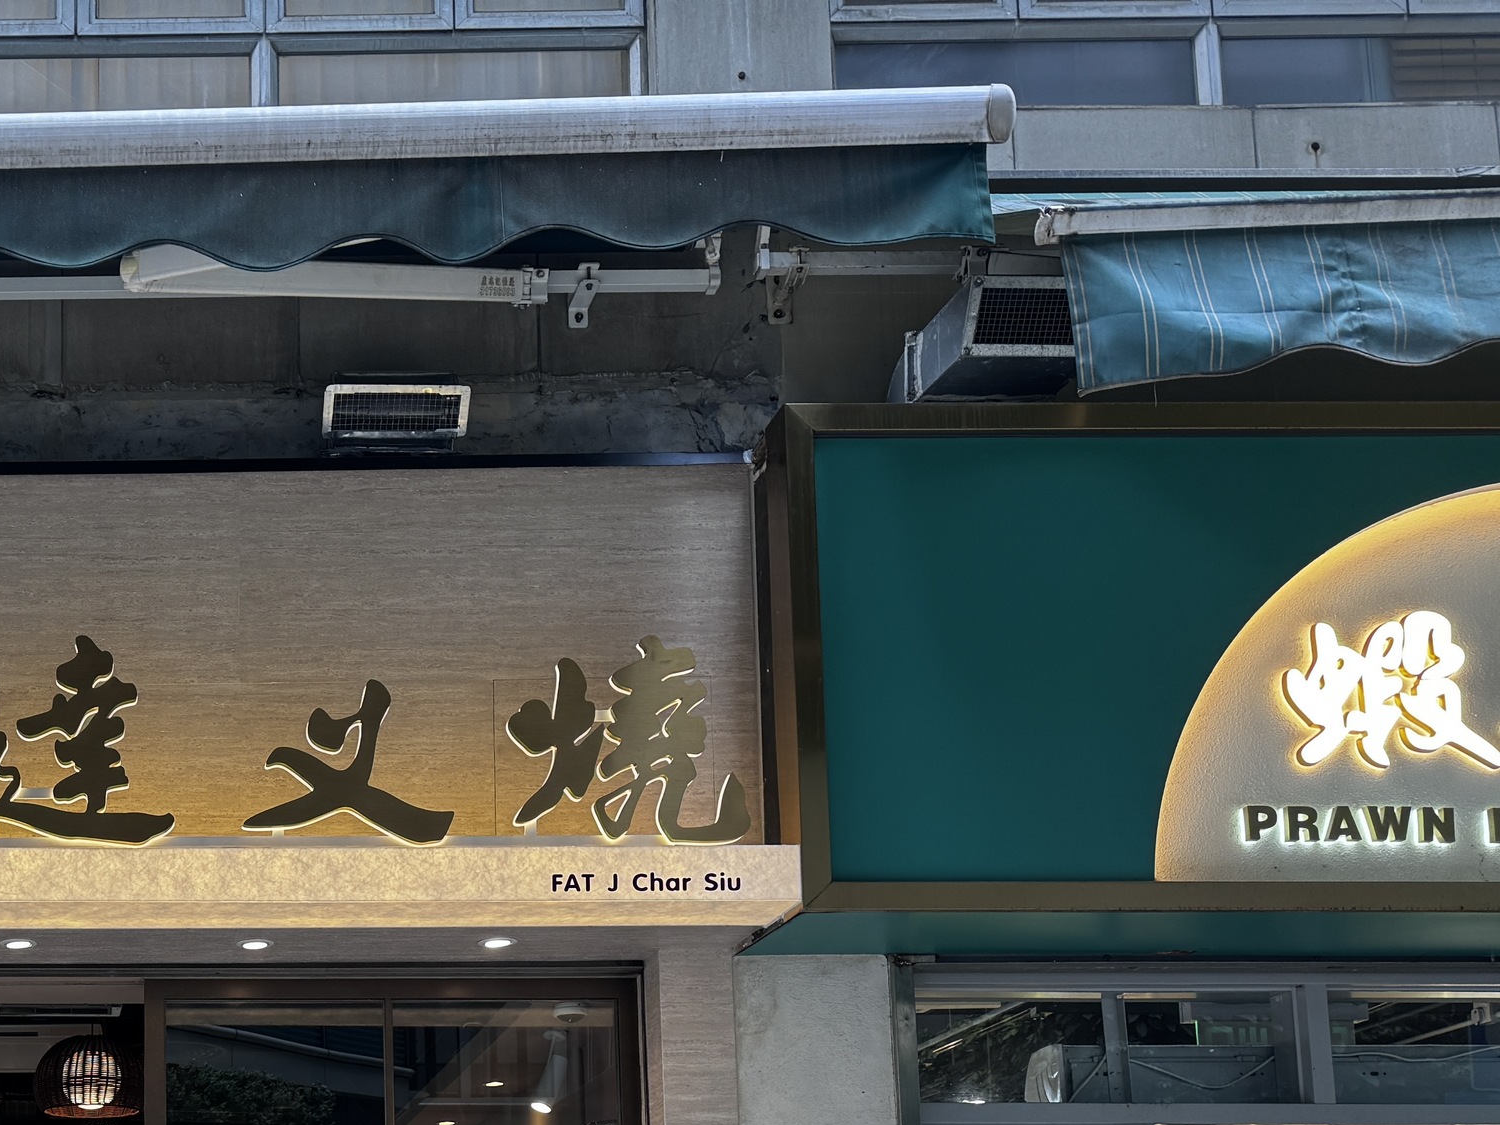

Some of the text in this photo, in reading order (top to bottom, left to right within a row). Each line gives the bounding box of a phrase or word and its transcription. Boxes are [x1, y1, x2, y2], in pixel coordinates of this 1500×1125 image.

[1244, 805, 1455, 843] PRAWN
[552, 872, 741, 892] FAT J Char Siu
